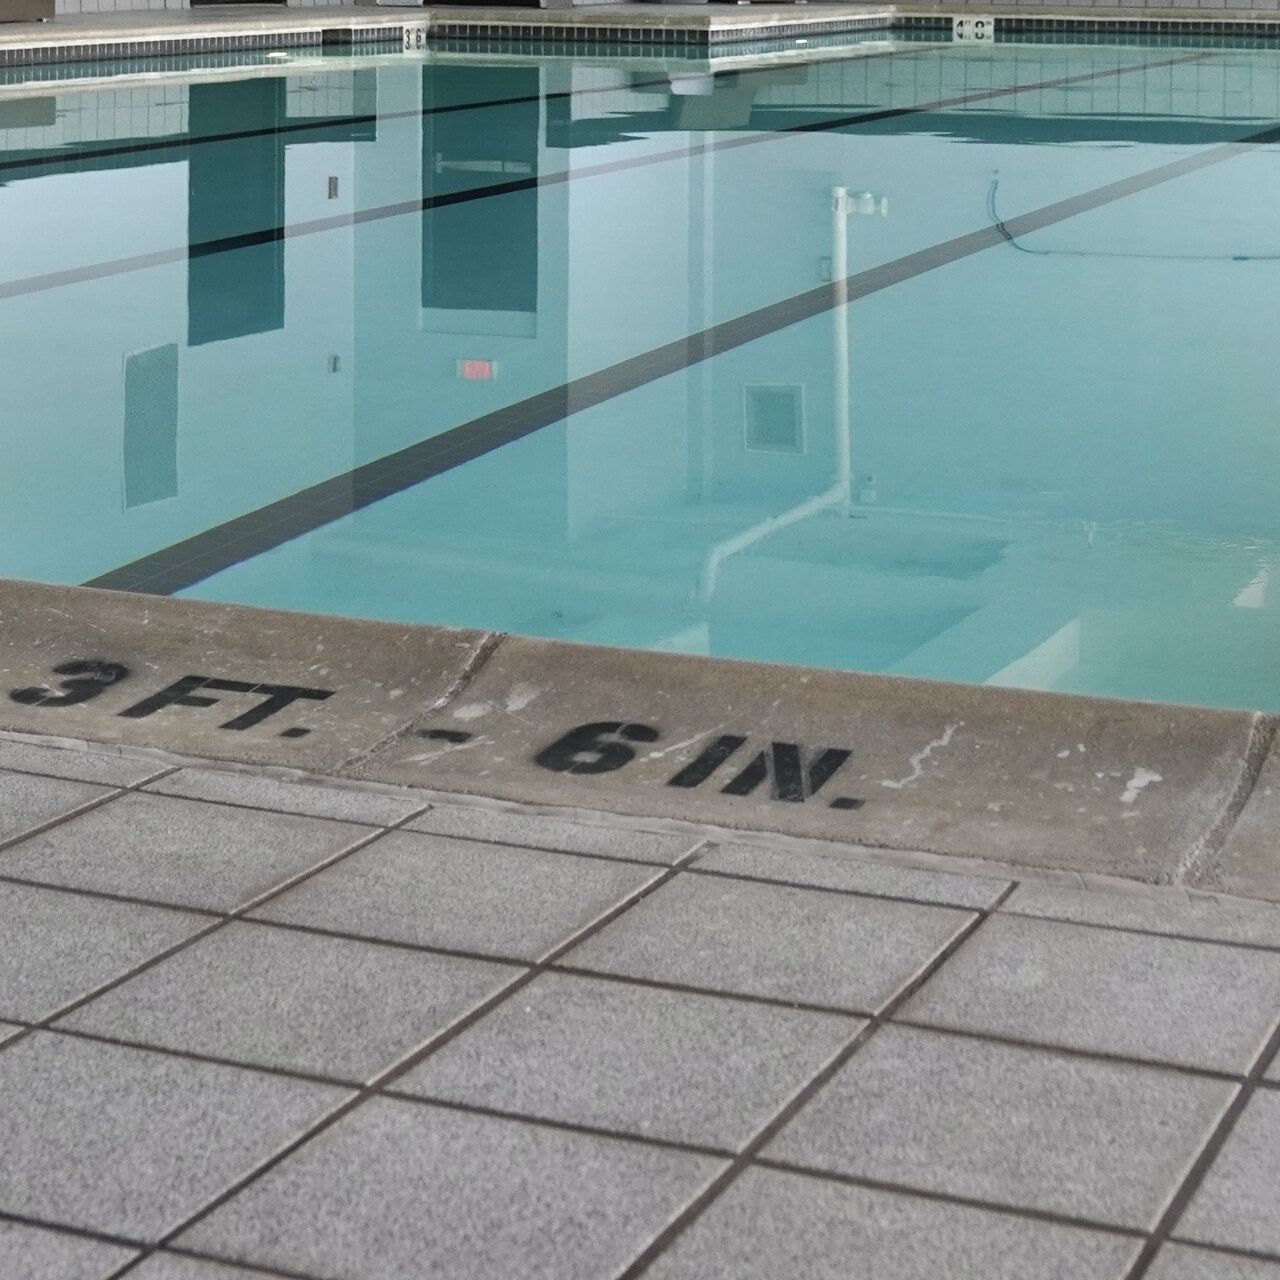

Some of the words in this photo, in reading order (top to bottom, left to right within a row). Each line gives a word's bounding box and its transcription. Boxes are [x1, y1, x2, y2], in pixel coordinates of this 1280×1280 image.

[9, 660, 130, 707] 3
[117, 675, 336, 738] FT.
[535, 721, 661, 775] 6
[666, 734, 867, 811] IN.
